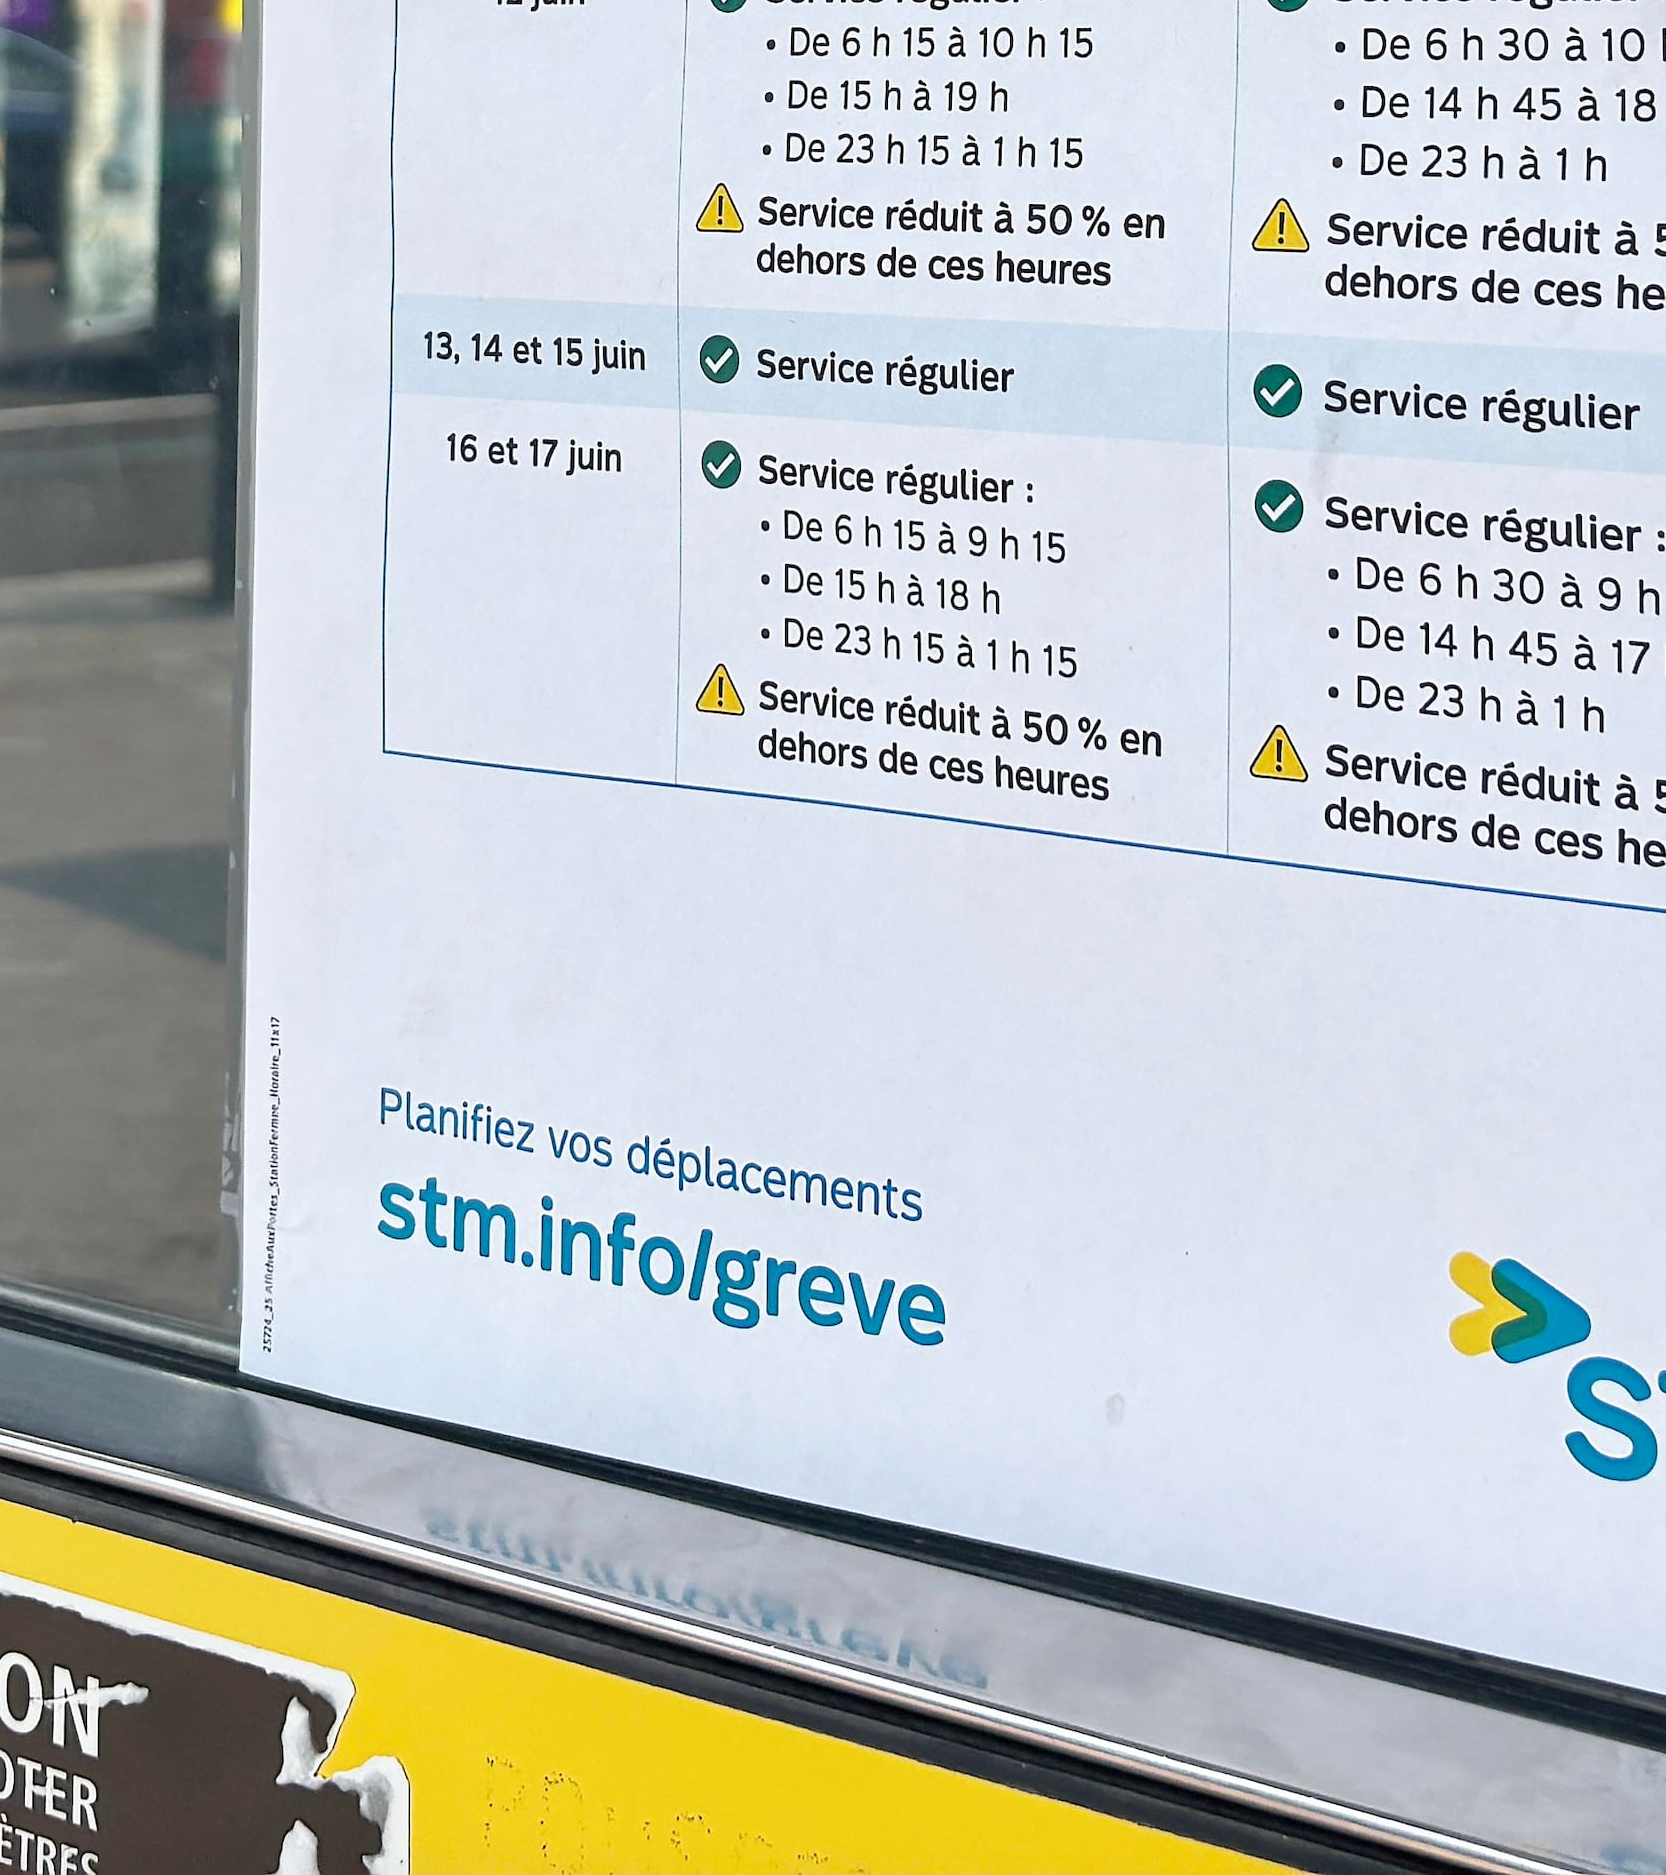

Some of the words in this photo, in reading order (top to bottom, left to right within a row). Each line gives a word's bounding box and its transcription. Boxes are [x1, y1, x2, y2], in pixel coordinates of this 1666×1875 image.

[1362, 86, 1409, 118] De
[1425, 86, 1462, 119] 14
[1478, 86, 1498, 120] h
[1513, 87, 1561, 121] 45
[1578, 87, 1600, 121] à
[1615, 88, 1656, 122] 18
[758, 196, 874, 229] Service
[886, 198, 983, 233] réduit
[994, 201, 1014, 234] à
[1027, 204, 1072, 235] 50
[1124, 213, 1165, 239] en
[1327, 213, 1467, 250] Service
[1482, 217, 1600, 255] réduit
[1614, 221, 1639, 256] à
[757, 242, 865, 276] dehors
[877, 246, 916, 278] de
[928, 256, 984, 281] ces
[996, 250, 1111, 286] heures
[1325, 263, 1457, 301] dehors
[1472, 269, 1519, 304] de
[1534, 279, 1602, 308] ces
[424, 331, 459, 365] 13,
[471, 333, 502, 362] 14
[513, 337, 542, 364] et
[553, 337, 582, 366] 15
[592, 340, 645, 375] juin
[757, 349, 873, 384] Service
[886, 355, 1014, 395] régulier
[1324, 380, 1467, 420] Service
[1483, 389, 1640, 433] régulier
[447, 433, 477, 462] 16
[488, 437, 518, 465] et
[530, 438, 558, 467] 17
[566, 439, 621, 476] juin
[759, 455, 873, 492] Service
[887, 464, 1014, 505] régulier
[1325, 496, 1468, 538] Service
[1484, 508, 1642, 552] régulier
[1357, 557, 1404, 592] De
[1420, 562, 1441, 596] 6
[1458, 564, 1477, 599] h
[1494, 568, 1544, 604] 30
[1561, 573, 1583, 609] à
[1599, 577, 1621, 611] 9
[1639, 579, 1660, 616] h
[759, 681, 874, 722] Service
[886, 695, 980, 736] réduit
[992, 706, 1011, 740] à
[1023, 710, 1068, 745] 50
[1120, 729, 1161, 757] en
[758, 728, 867, 769] dehors
[879, 742, 918, 775] de
[929, 755, 984, 784] ces
[996, 755, 1109, 801] heures
[1326, 744, 1467, 791] Service
[1482, 761, 1600, 807] réduit
[1615, 774, 1639, 811] à
[1325, 797, 1457, 843] dehors
[1472, 814, 1520, 850] de
[1535, 828, 1603, 860] ces
[381, 1087, 534, 1153] Planifiez
[549, 1127, 612, 1167] vos
[627, 1135, 922, 1221] déplacements
[378, 1177, 946, 1346] stm.info/greve
